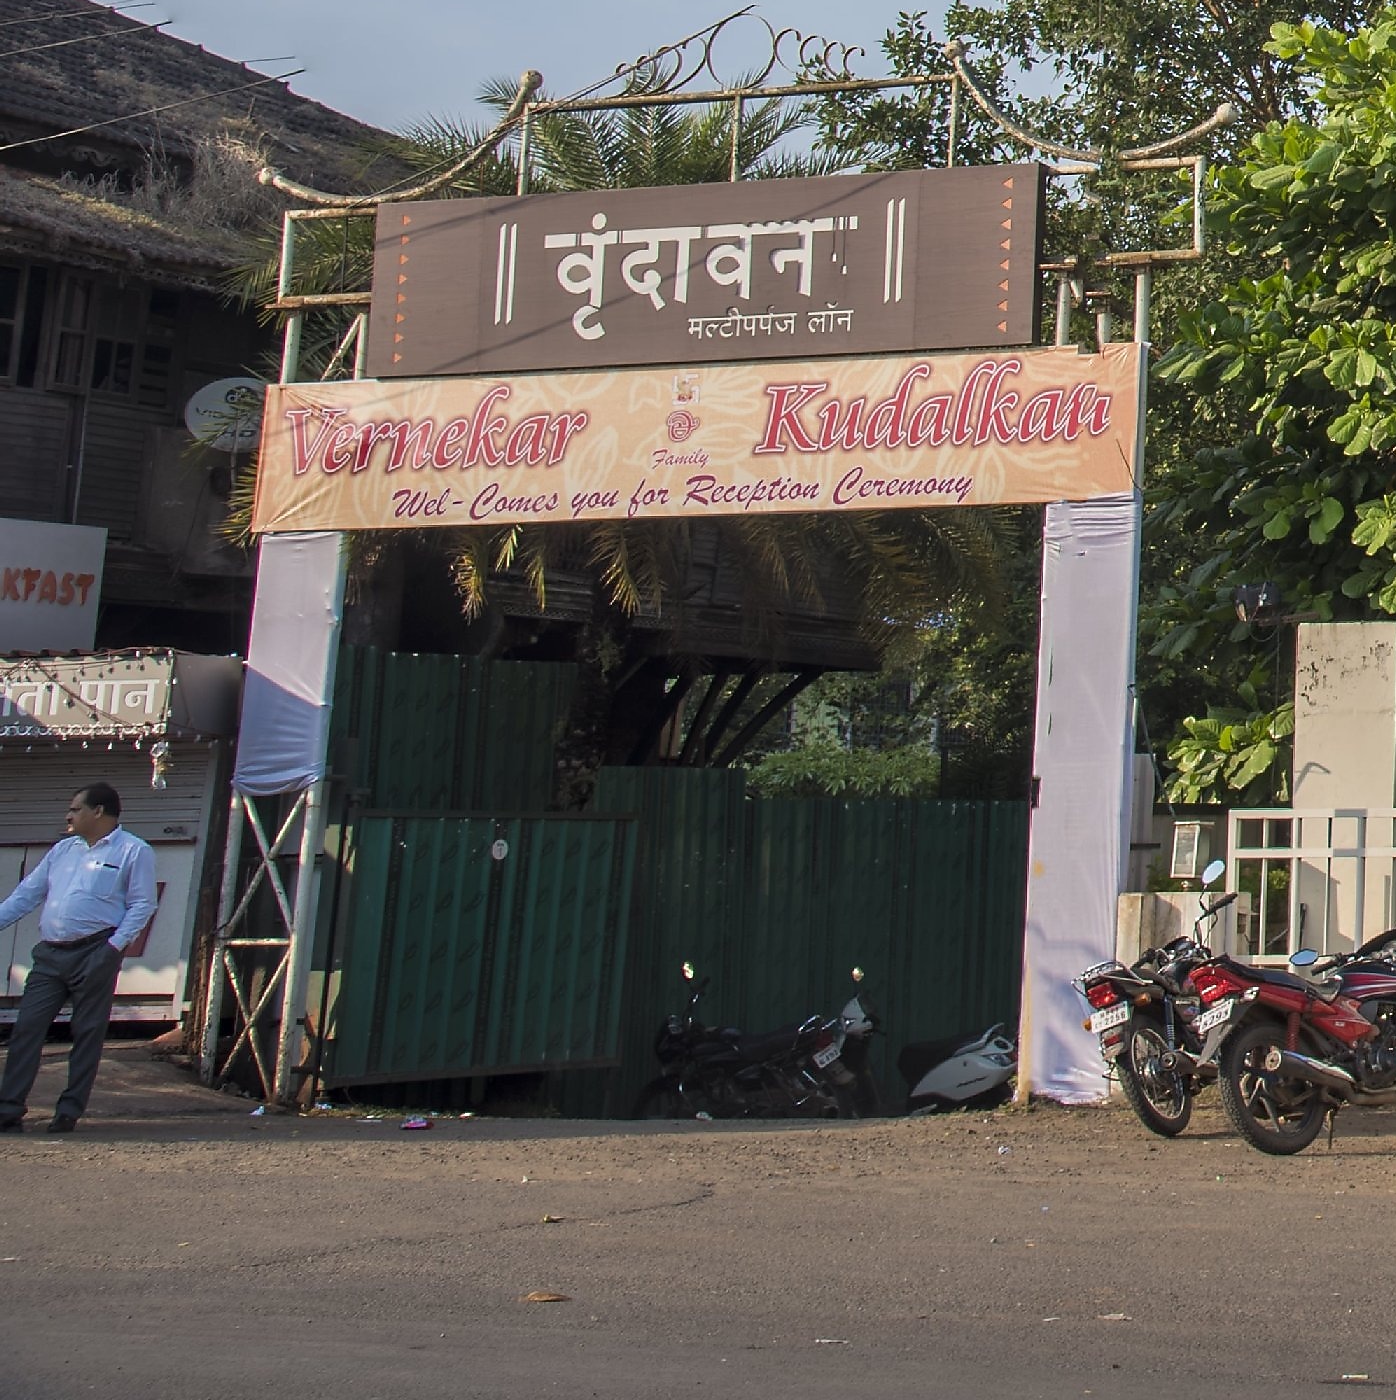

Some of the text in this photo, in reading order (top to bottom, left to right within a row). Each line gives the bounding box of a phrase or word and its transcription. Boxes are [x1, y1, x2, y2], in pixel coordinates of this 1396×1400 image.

[544, 212, 858, 340] वृंदावन
[807, 301, 854, 333] लॉन
[285, 386, 588, 476] Vernekar
[650, 447, 710, 471] Family
[571, 489, 620, 518] you
[627, 478, 669, 518] for
[683, 473, 820, 510] Reception
[832, 466, 974, 505] Ceremony
[2, 566, 96, 607] KFAST
[79, 678, 160, 715] पान
